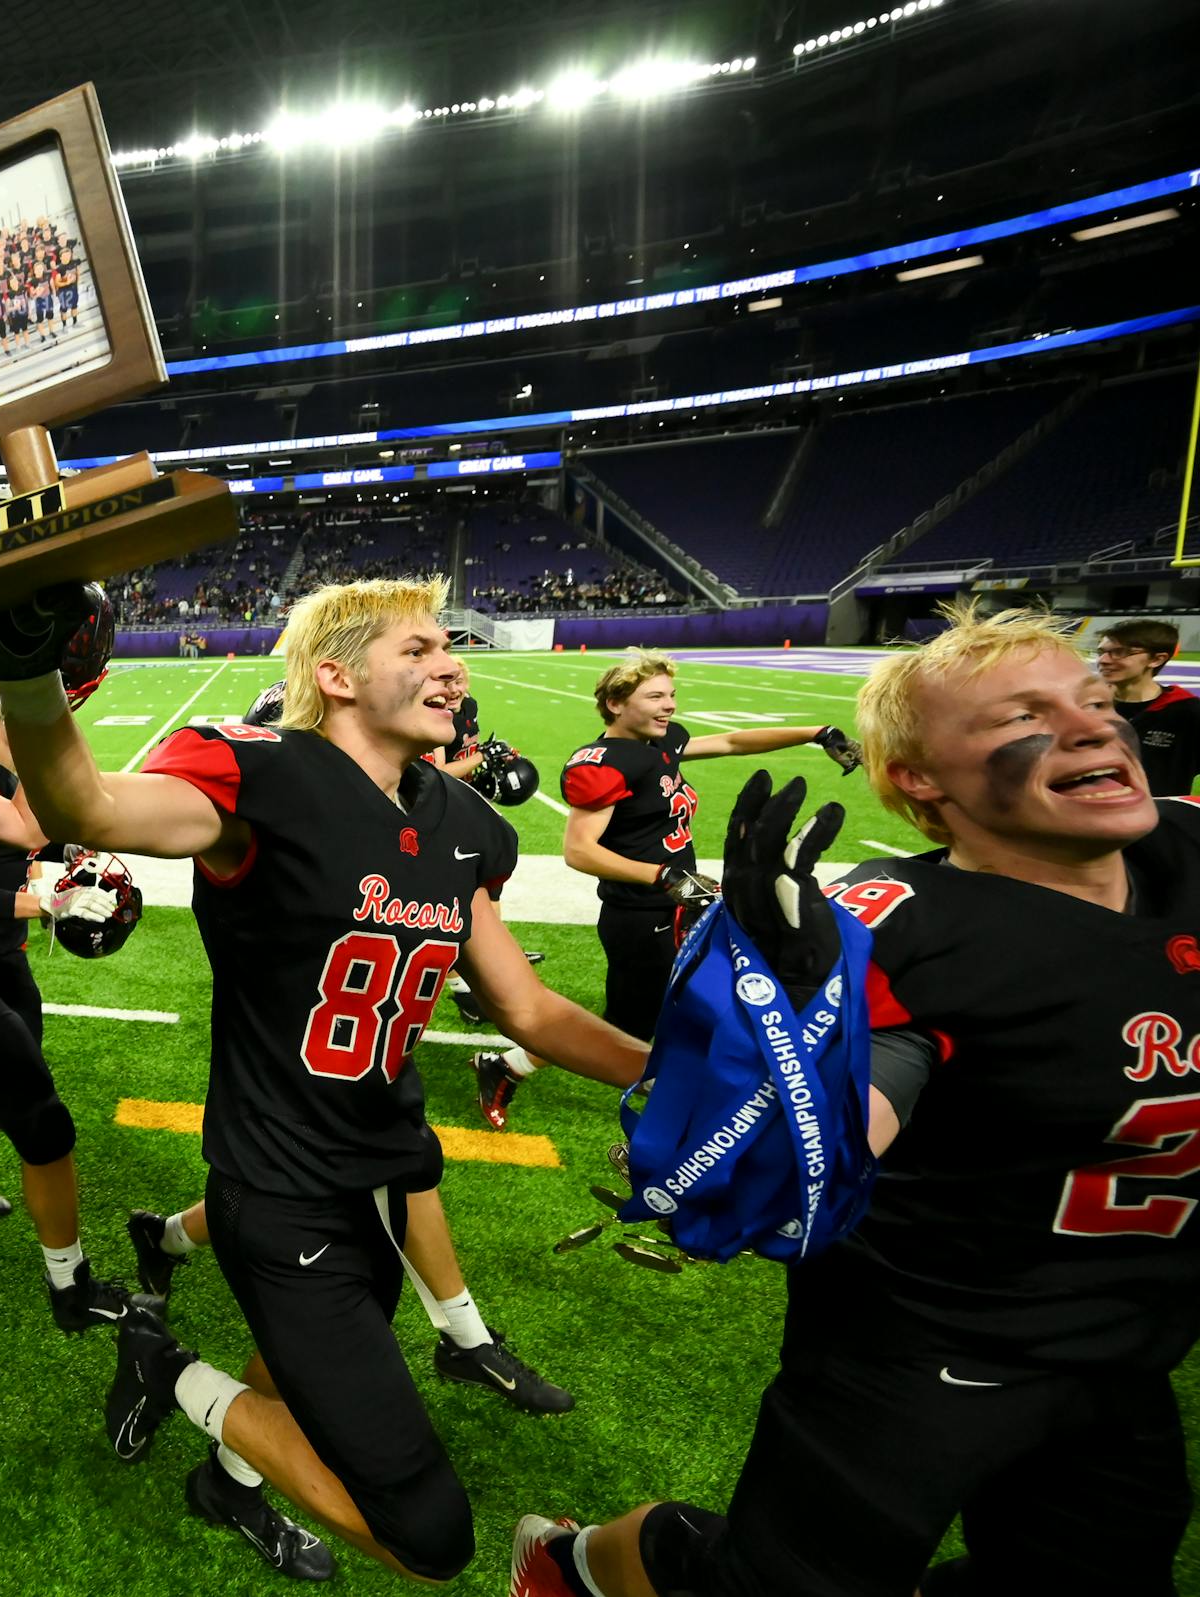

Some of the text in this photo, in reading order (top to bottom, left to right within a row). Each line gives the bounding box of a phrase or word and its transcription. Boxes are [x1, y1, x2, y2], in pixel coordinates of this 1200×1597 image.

[459, 459, 492, 474] GREAT
[353, 873, 464, 933] Rocori
[300, 930, 460, 1085] 88
[665, 1076, 781, 1196] HAMPIONSHIPS
[760, 1010, 826, 1178] CHAMPIONSHIPS
[1053, 1092, 1200, 1239] 2
